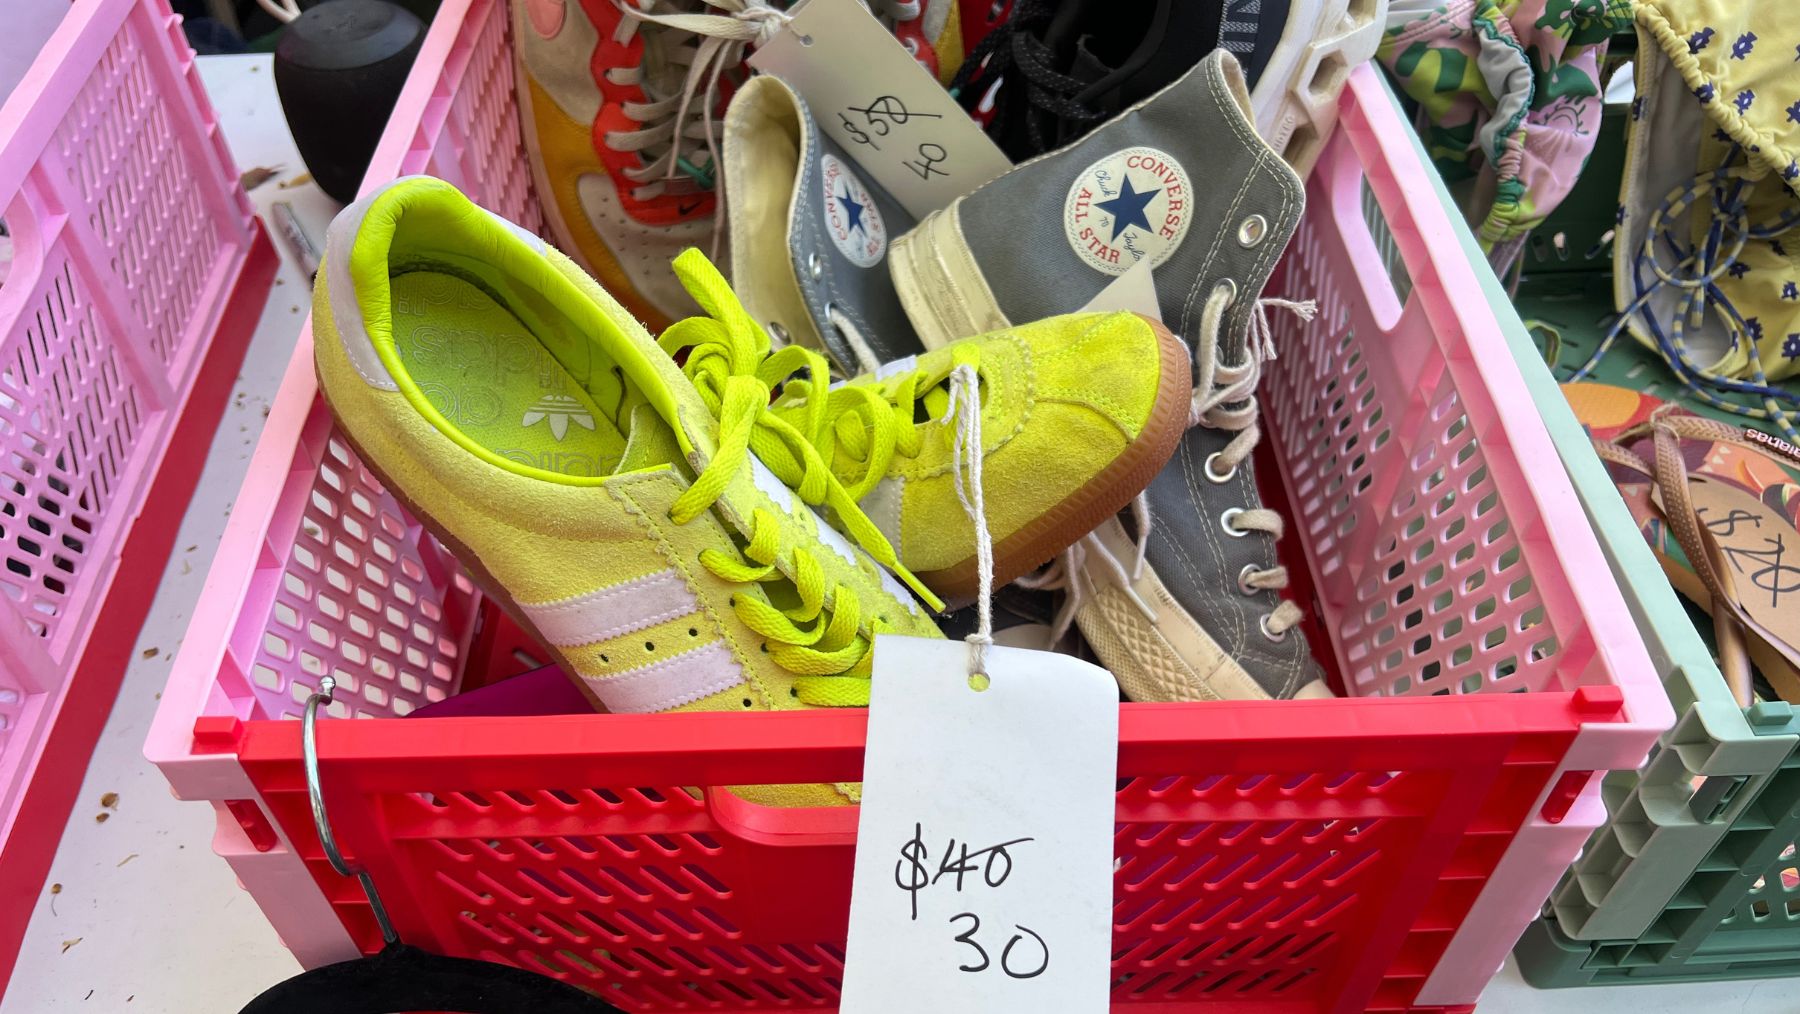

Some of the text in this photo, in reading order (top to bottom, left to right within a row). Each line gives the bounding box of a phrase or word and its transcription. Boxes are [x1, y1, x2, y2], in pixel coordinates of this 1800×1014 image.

[902, 143, 950, 180] 40
[1075, 187, 1121, 264] ALL STAR
[1126, 155, 1184, 241] CONVERSE
[1746, 428, 1800, 458] aianas
[894, 822, 1020, 921] $40
[949, 912, 1049, 979] 30
